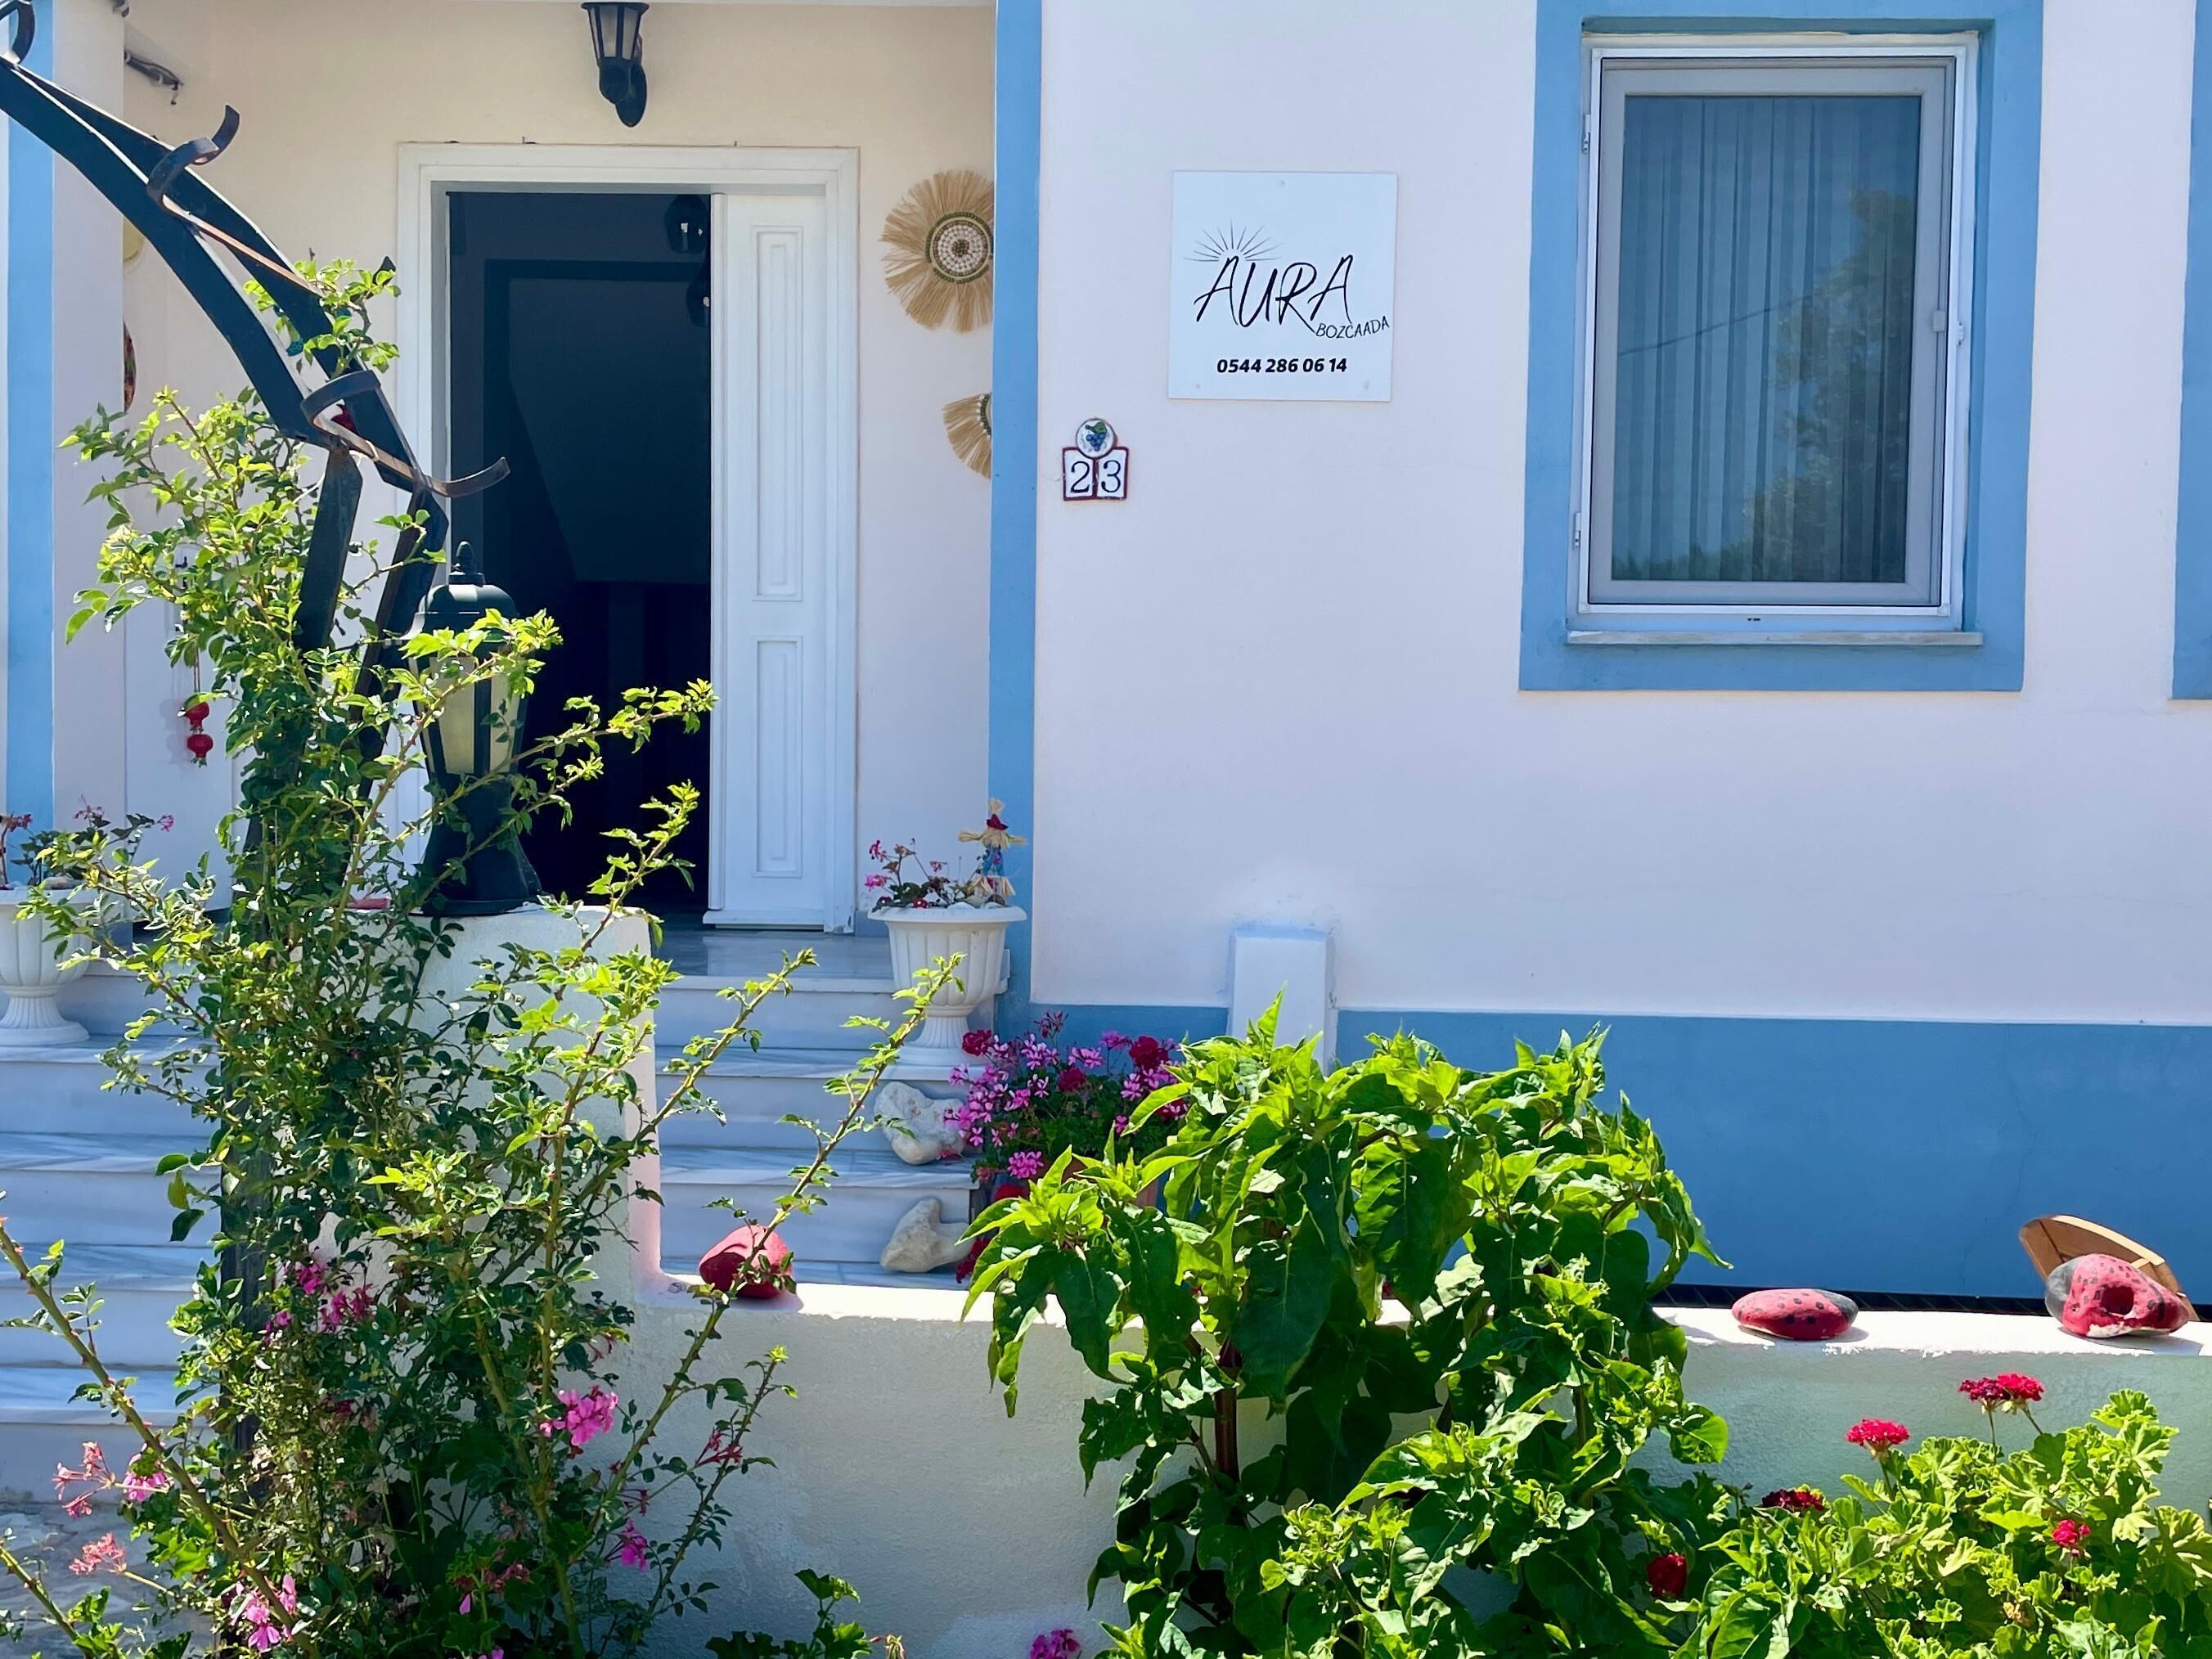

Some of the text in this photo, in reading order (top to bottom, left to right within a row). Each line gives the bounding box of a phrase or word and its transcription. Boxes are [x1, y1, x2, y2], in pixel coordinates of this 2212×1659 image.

[1194, 254, 1354, 330] AURA
[1315, 316, 1390, 339] BOZCAADA
[1216, 357, 1347, 373] 0544 286 06 14
[1070, 460, 1121, 493] 23
